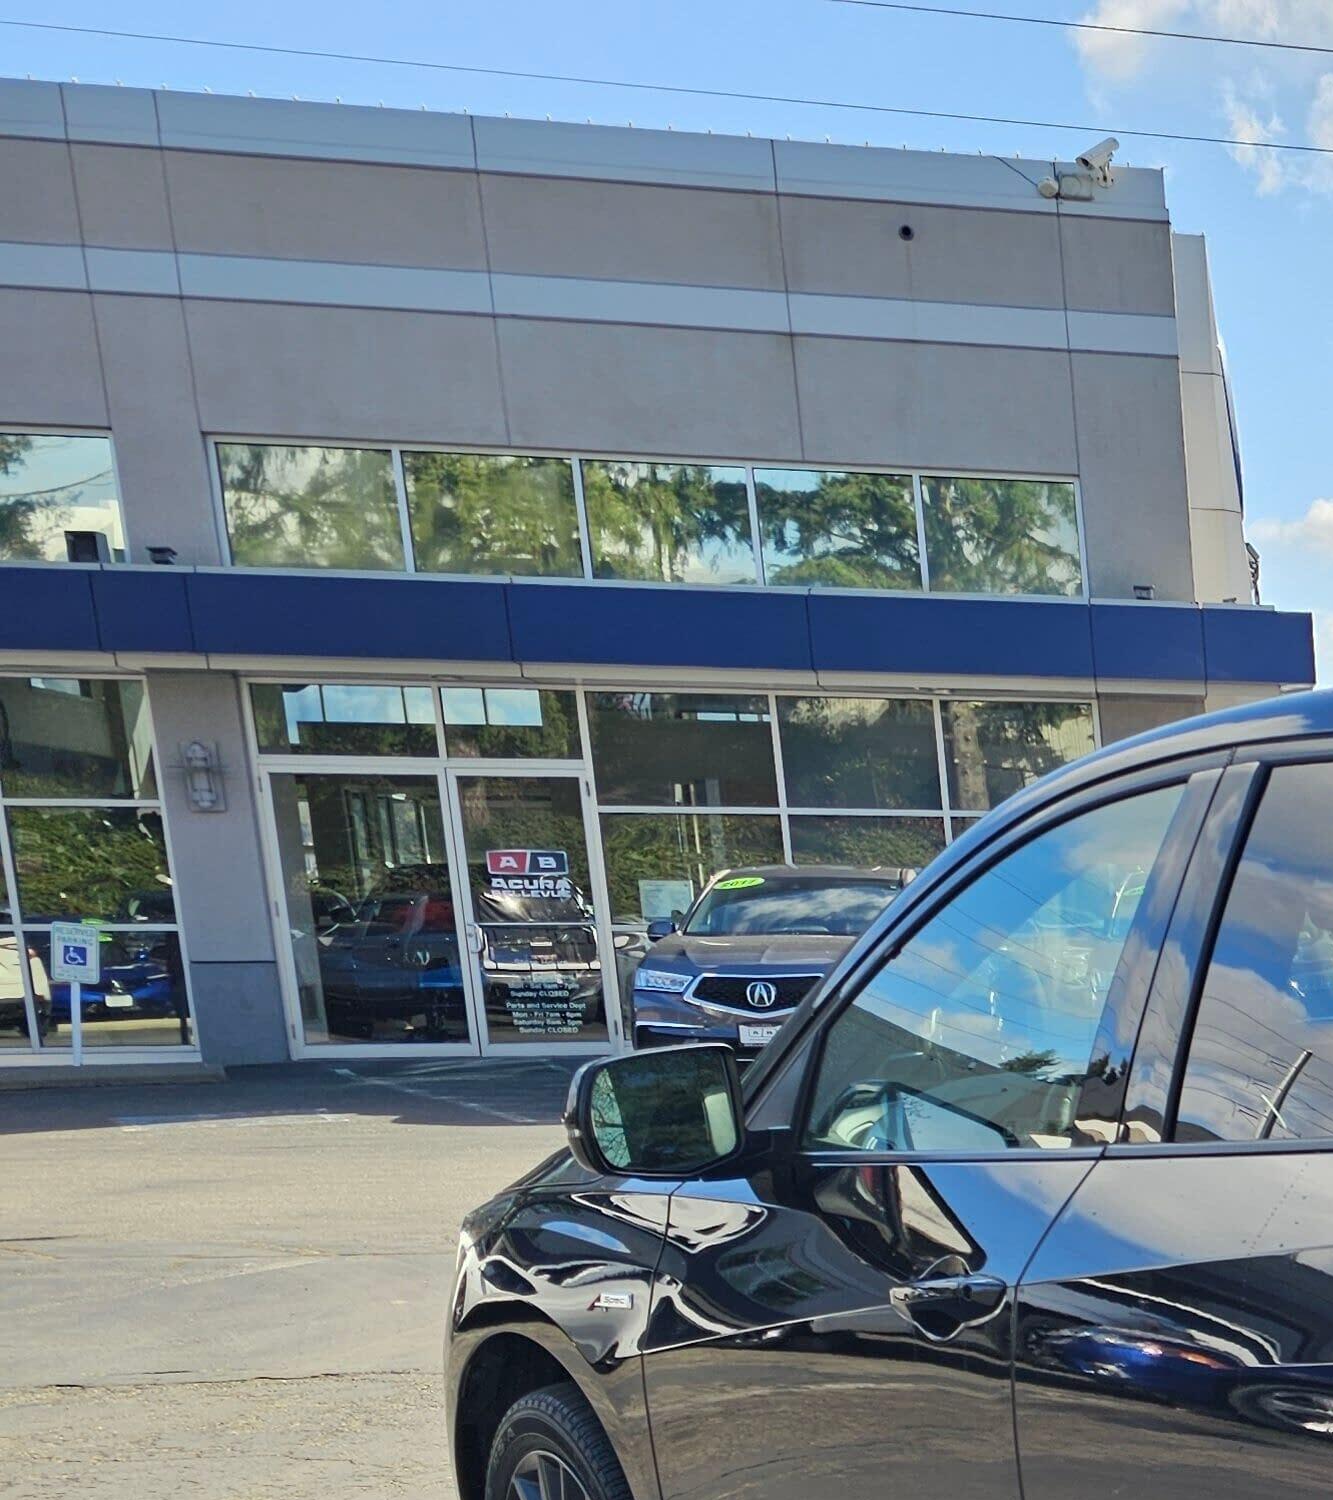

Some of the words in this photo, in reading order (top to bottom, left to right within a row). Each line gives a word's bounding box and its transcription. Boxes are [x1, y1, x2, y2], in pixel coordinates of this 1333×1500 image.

[500, 856, 518, 869] A
[537, 856, 557, 869] B
[491, 877, 572, 890] ACURA
[569, 1002, 586, 1010] Dept
[547, 1026, 579, 1034] CLOSED
